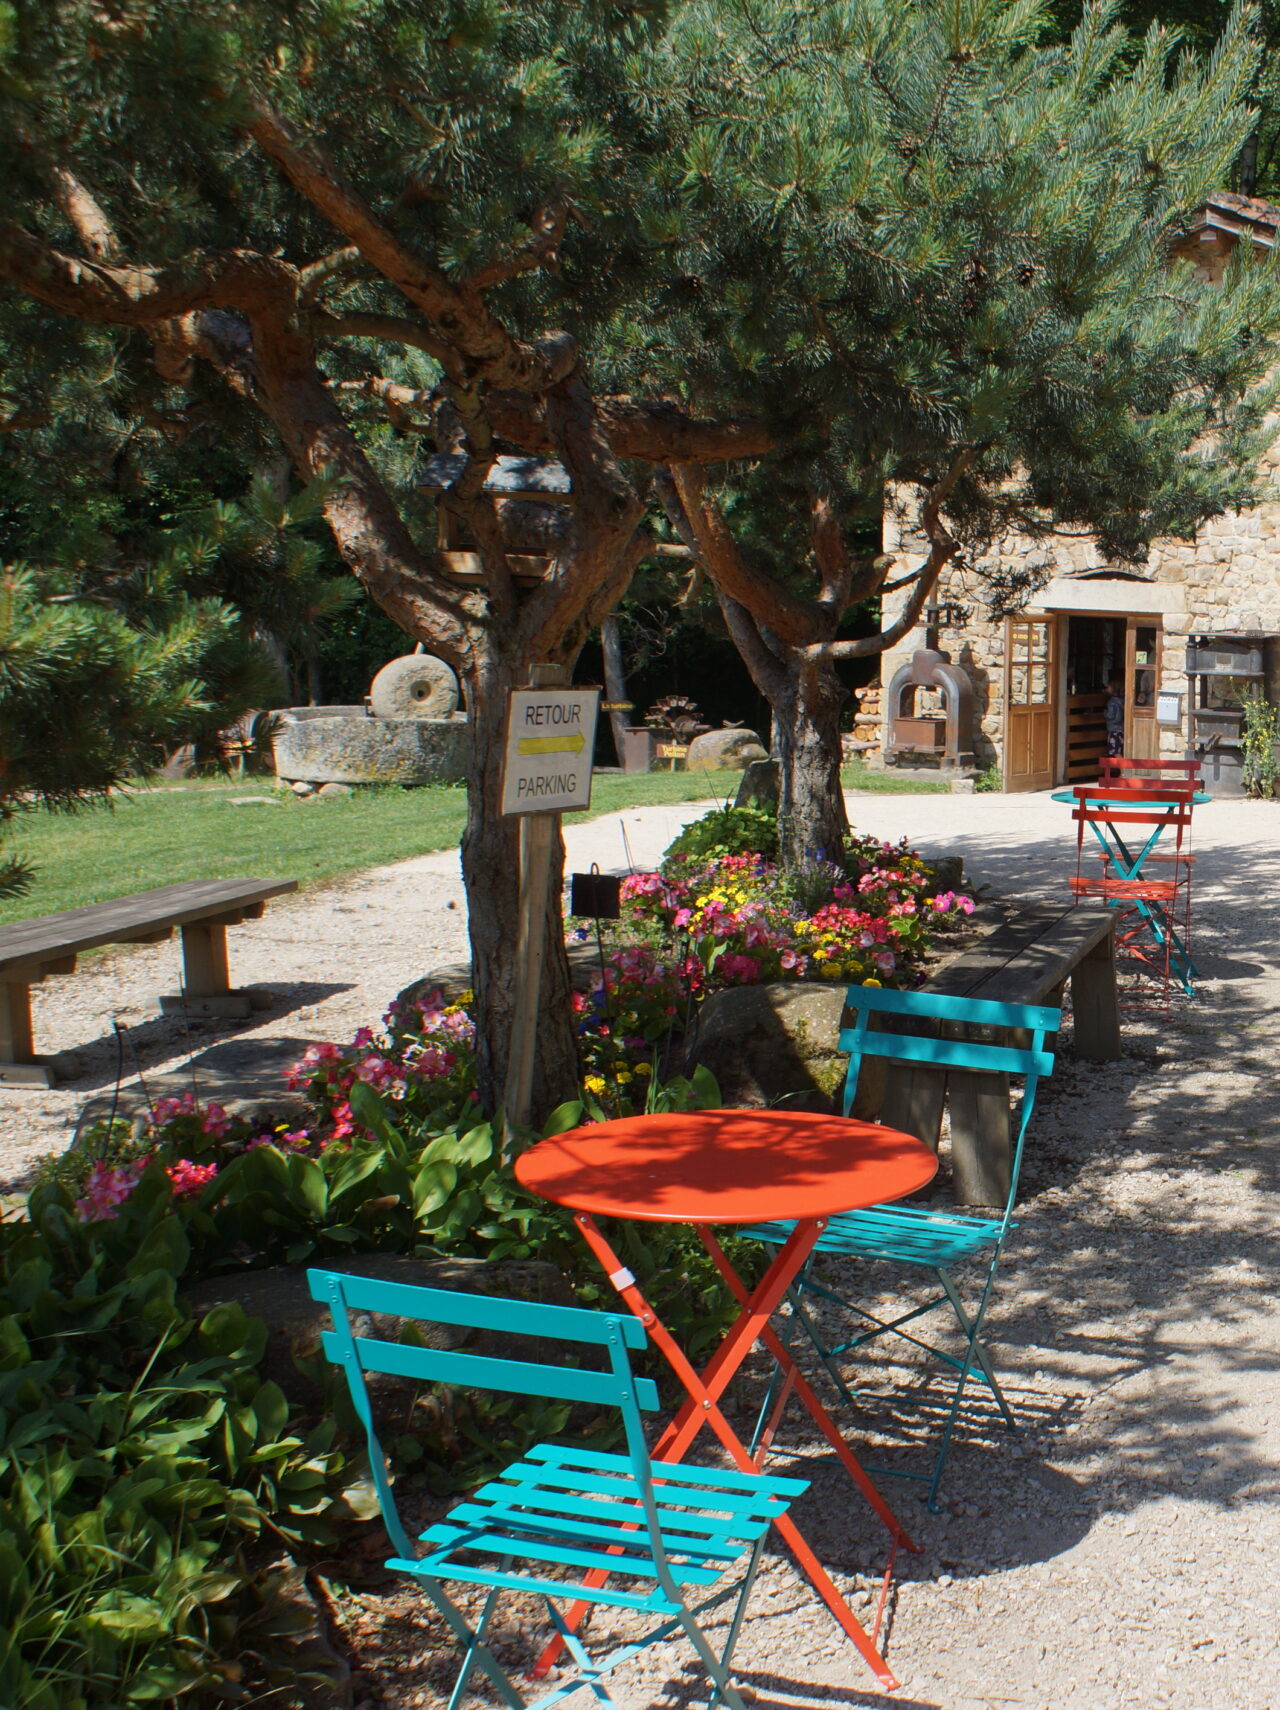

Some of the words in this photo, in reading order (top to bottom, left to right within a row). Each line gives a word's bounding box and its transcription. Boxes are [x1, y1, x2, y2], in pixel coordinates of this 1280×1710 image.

[525, 704, 581, 725] RETOUR
[662, 744, 688, 753] Turbine
[517, 773, 577, 798] PARKING
